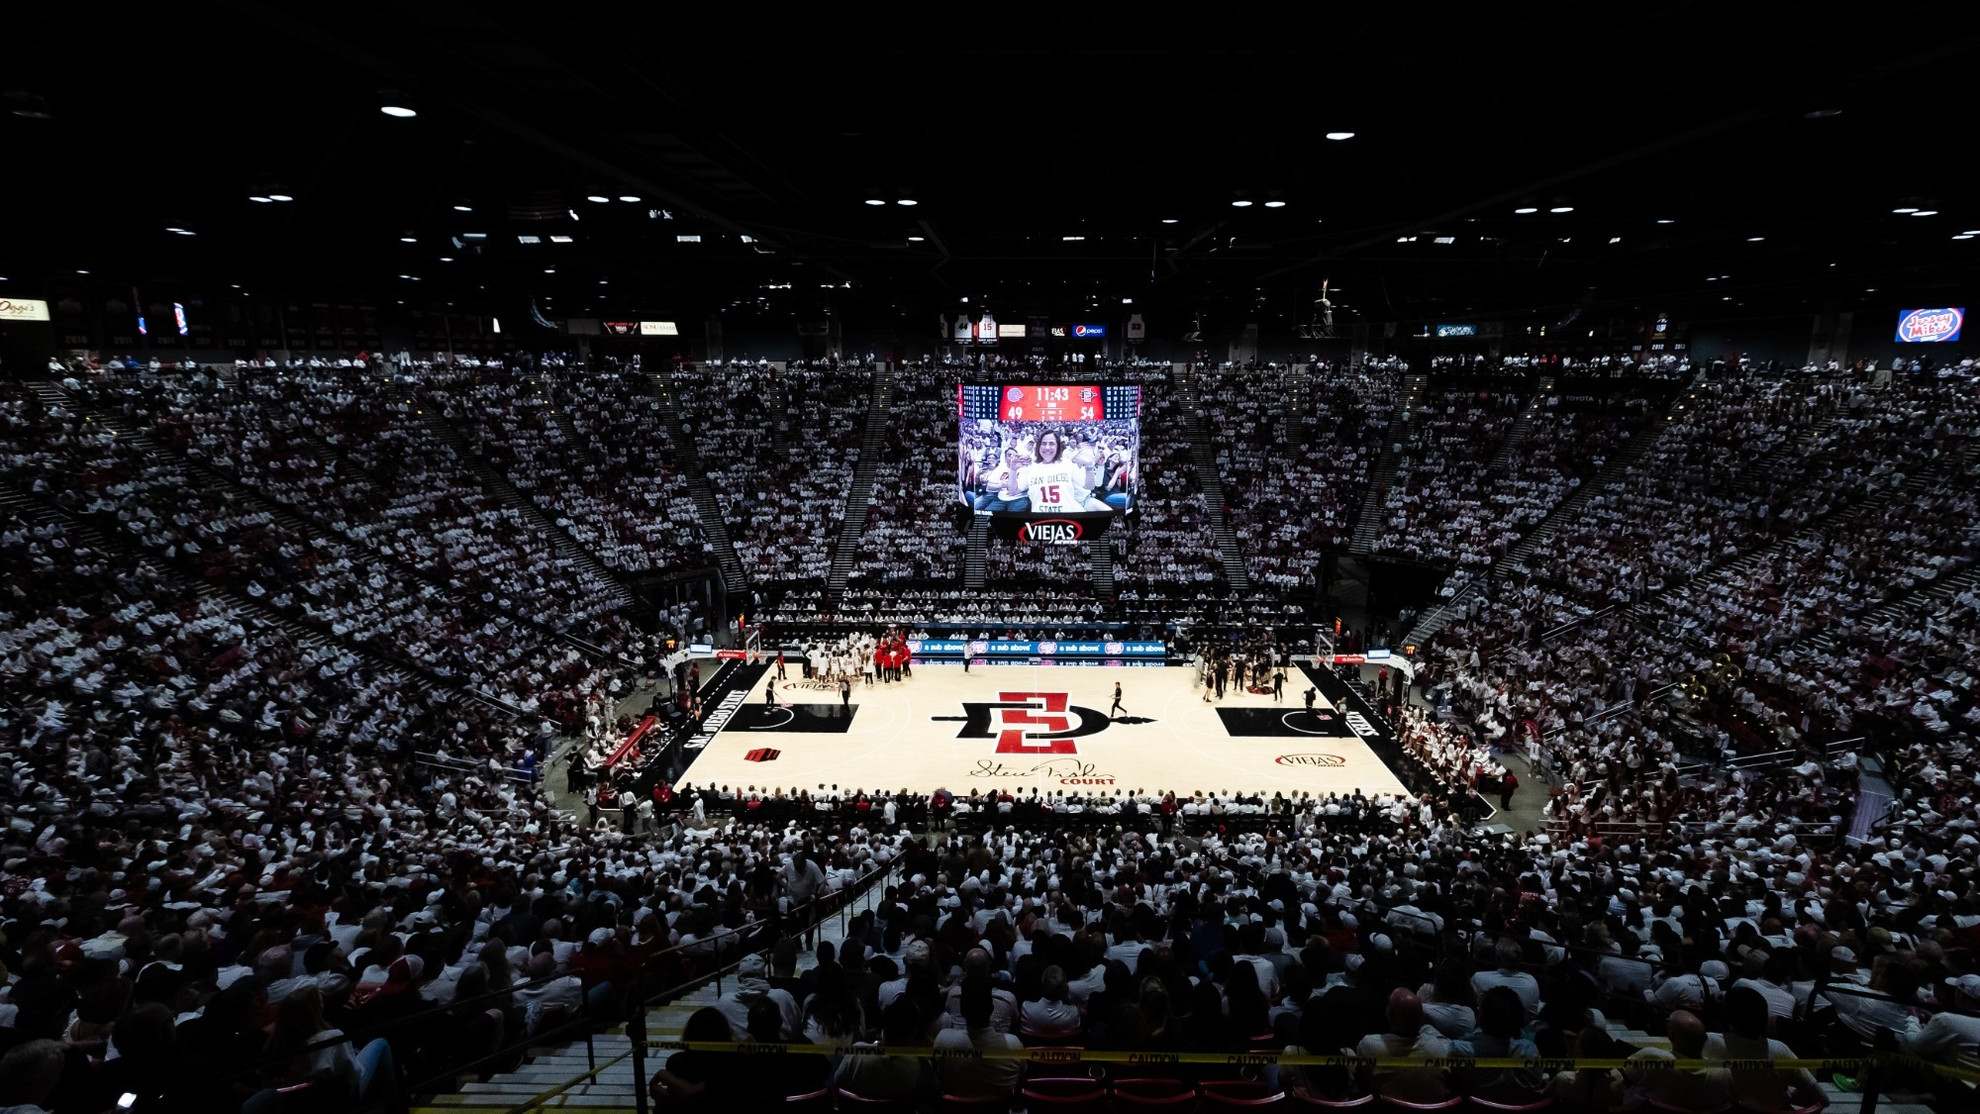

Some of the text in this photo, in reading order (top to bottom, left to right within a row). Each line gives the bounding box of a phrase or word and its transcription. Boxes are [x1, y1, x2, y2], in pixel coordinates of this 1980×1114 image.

[983, 323, 992, 331] 15
[1086, 327, 1103, 335] pepsi
[1036, 387, 1069, 401] 11:43
[1008, 406, 1023, 420] 49
[1080, 406, 1095, 420] 54
[1040, 485, 1060, 503] 15
[1025, 522, 1075, 544] VIEJAS
[1065, 644, 1078, 652] sub
[717, 690, 749, 709] STATE
[703, 709, 733, 732] DIEGO
[1280, 754, 1338, 766] VIEJAS
[835, 1047, 885, 1056] CAUTION
[933, 1050, 983, 1058] CAUTION
[1031, 1051, 1081, 1061] CAUTION
[1129, 1053, 1180, 1064] CAUTION
[1227, 1056, 1277, 1064] CAUTION
[1326, 1057, 1376, 1066] CAUTION
[1425, 1059, 1475, 1068] CAUTION
[1524, 1060, 1575, 1069] CAUTION
[1624, 1060, 1675, 1070] CAUTION
[1723, 1061, 1774, 1070] CAUTION
